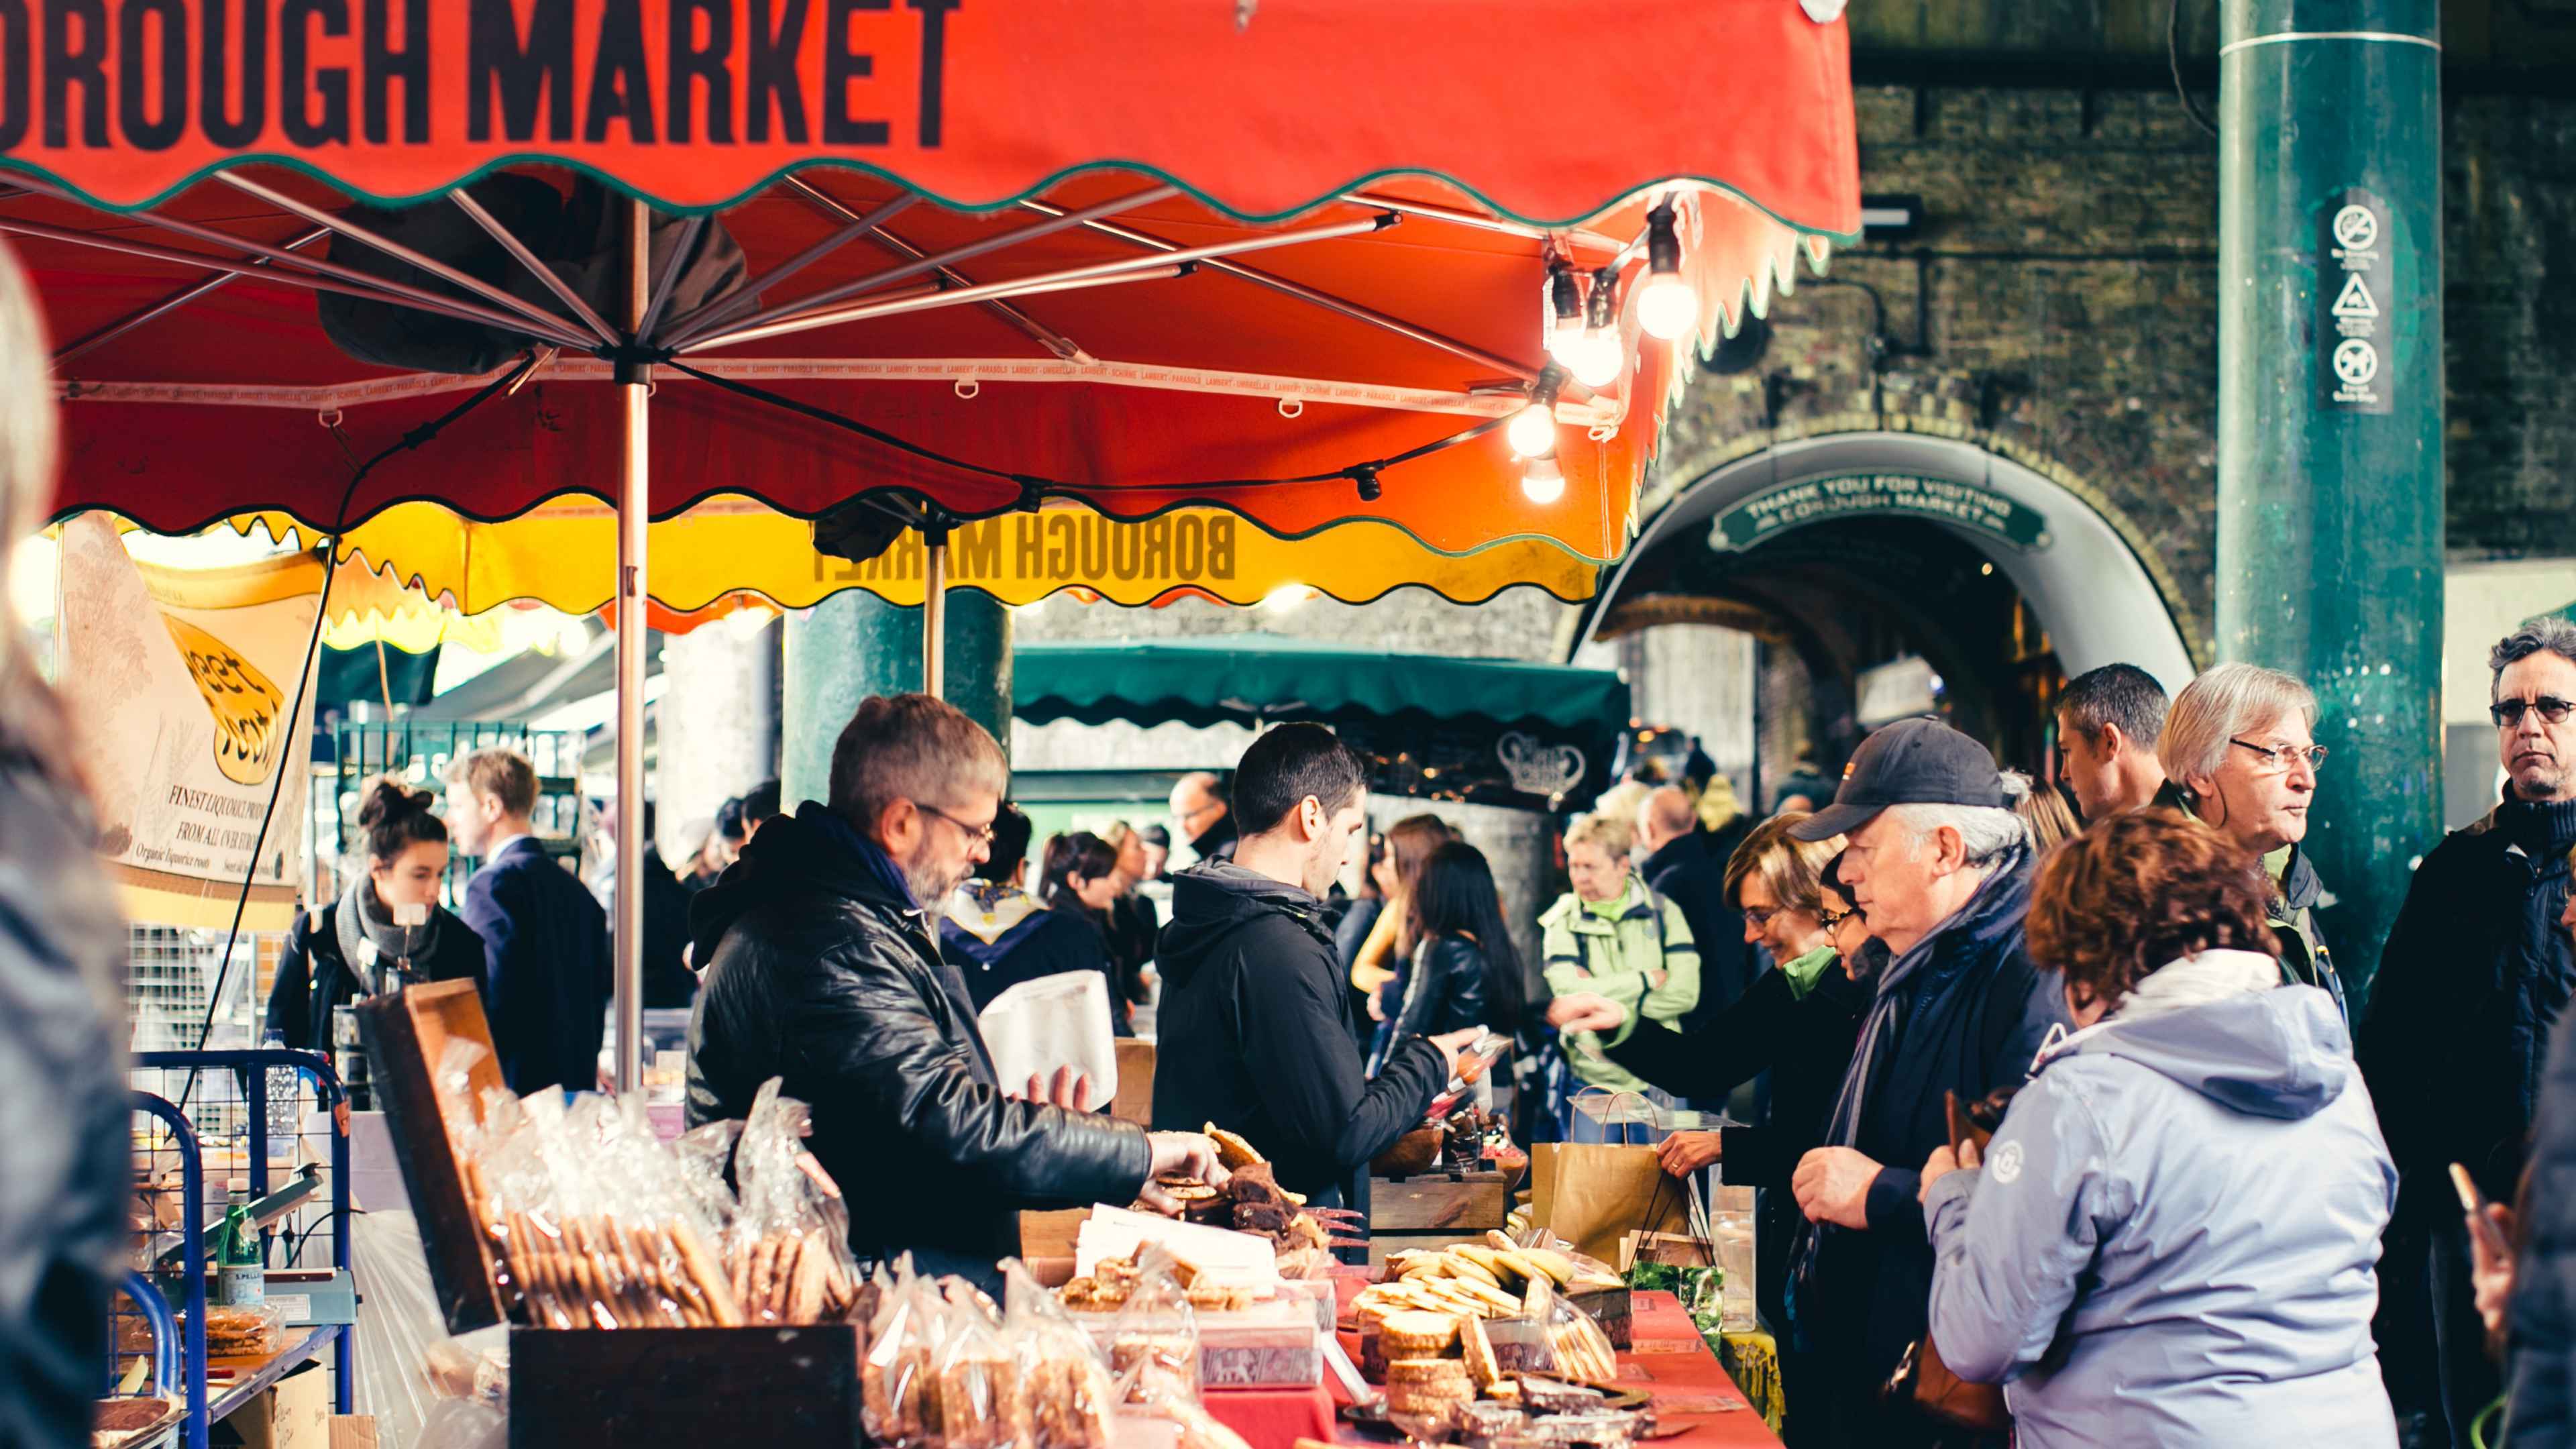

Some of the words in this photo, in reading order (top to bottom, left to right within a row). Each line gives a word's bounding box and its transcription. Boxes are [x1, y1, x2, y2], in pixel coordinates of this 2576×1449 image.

[468, 0, 961, 148] MARKET
[1746, 482, 1819, 519] THANK
[1823, 477, 1871, 496] YOU
[1874, 475, 1920, 494] FOR
[1921, 478, 2012, 519] VISITING
[1895, 492, 1984, 521] MARKET
[168, 784, 207, 810] FINEST
[176, 820, 206, 843] FROM
[204, 826, 221, 847] ALL
[136, 842, 164, 861] Organic
